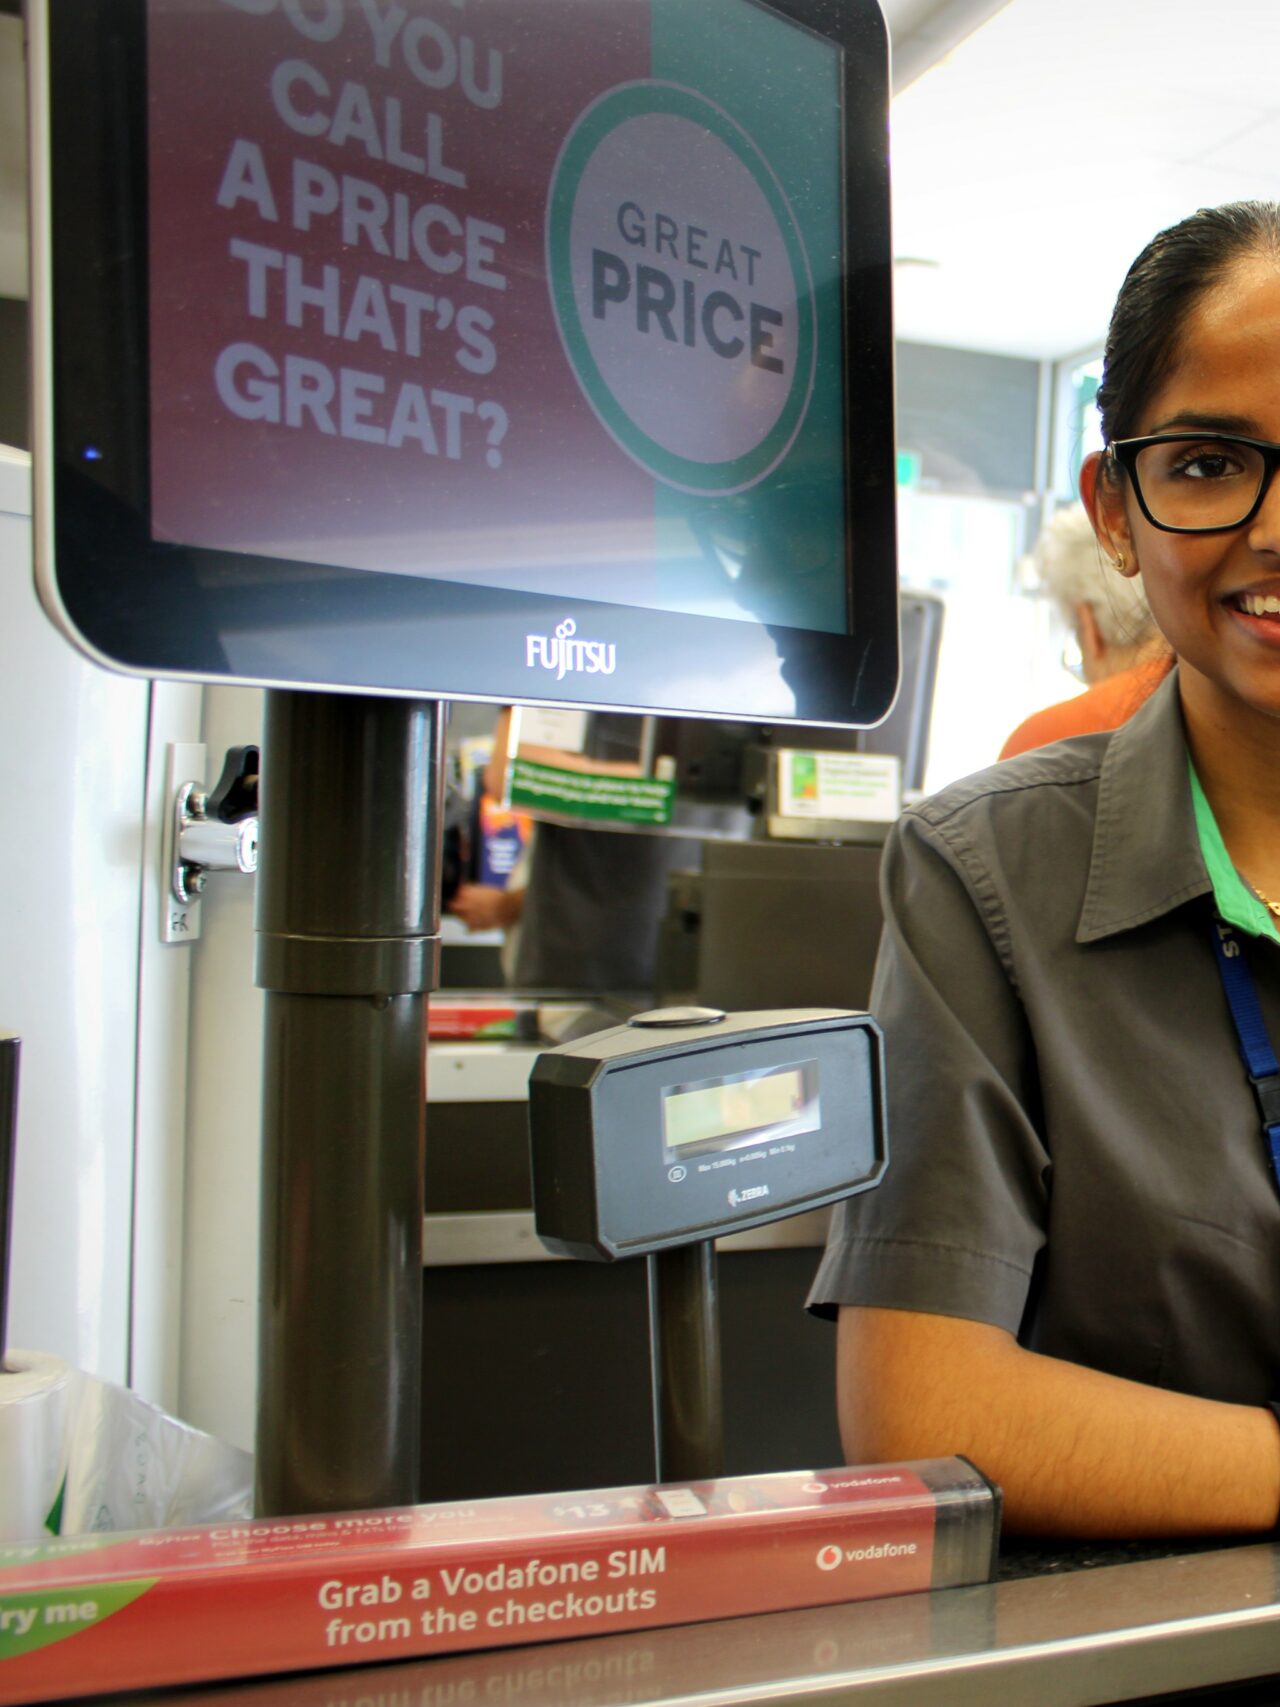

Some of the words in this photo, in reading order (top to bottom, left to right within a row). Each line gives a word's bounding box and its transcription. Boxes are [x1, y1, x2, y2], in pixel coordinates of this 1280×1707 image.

[220, 0, 345, 42] O
[361, 0, 503, 110] YOU
[271, 58, 468, 189] CALL
[216, 138, 279, 222] A
[292, 158, 507, 291] PRICE
[617, 201, 761, 286] GREAT
[229, 237, 497, 375] THAT'S
[592, 247, 784, 375] PRICE
[214, 341, 509, 469] GREAT?
[526, 618, 616, 680] FUJITSU
[740, 1185, 769, 1201] ZEBRA
[829, 1474, 902, 1490] vodafone
[209, 1520, 328, 1541] Choose
[334, 1512, 413, 1529] more
[419, 1508, 477, 1524] you
[845, 1541, 917, 1561] vodafone
[318, 1576, 402, 1610] Grab
[411, 1578, 431, 1600] a
[440, 1558, 599, 1596] Vodafone
[607, 1547, 666, 1579] SIM
[0, 1606, 38, 1635] ry
[45, 1601, 98, 1624] me
[326, 1615, 412, 1646] from
[421, 1607, 478, 1636] the
[486, 1588, 657, 1628] checkouts
